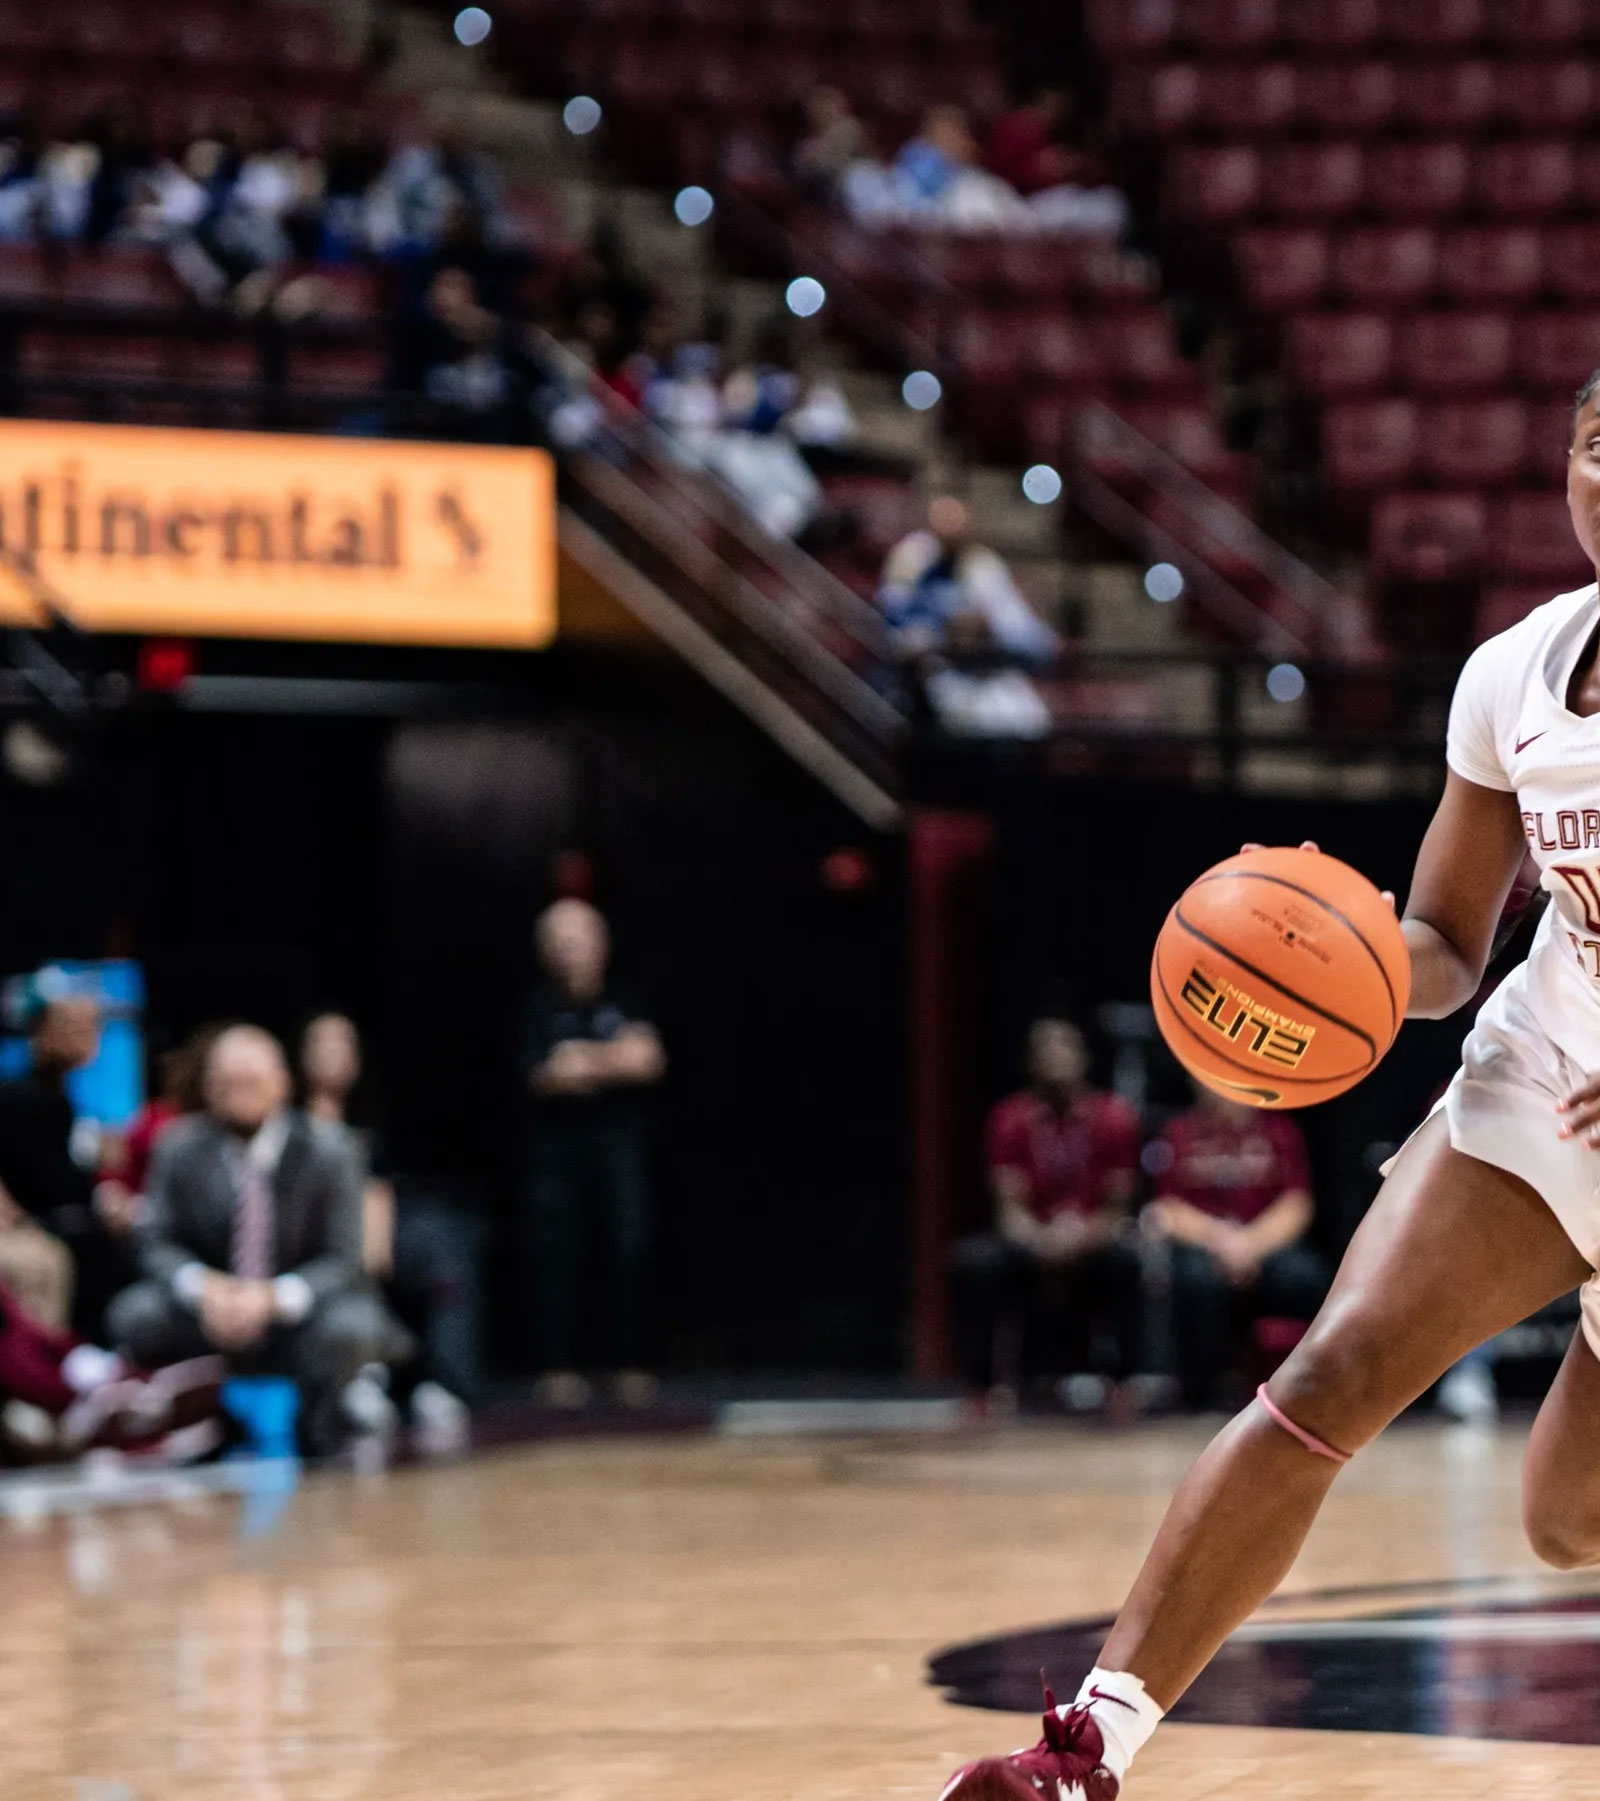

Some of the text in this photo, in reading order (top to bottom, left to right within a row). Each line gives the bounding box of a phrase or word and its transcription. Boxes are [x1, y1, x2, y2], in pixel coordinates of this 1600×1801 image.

[0, 464, 401, 570] tinental
[1180, 965, 1311, 1070] ELITE
[1217, 976, 1317, 1038] CHAMPIONS
